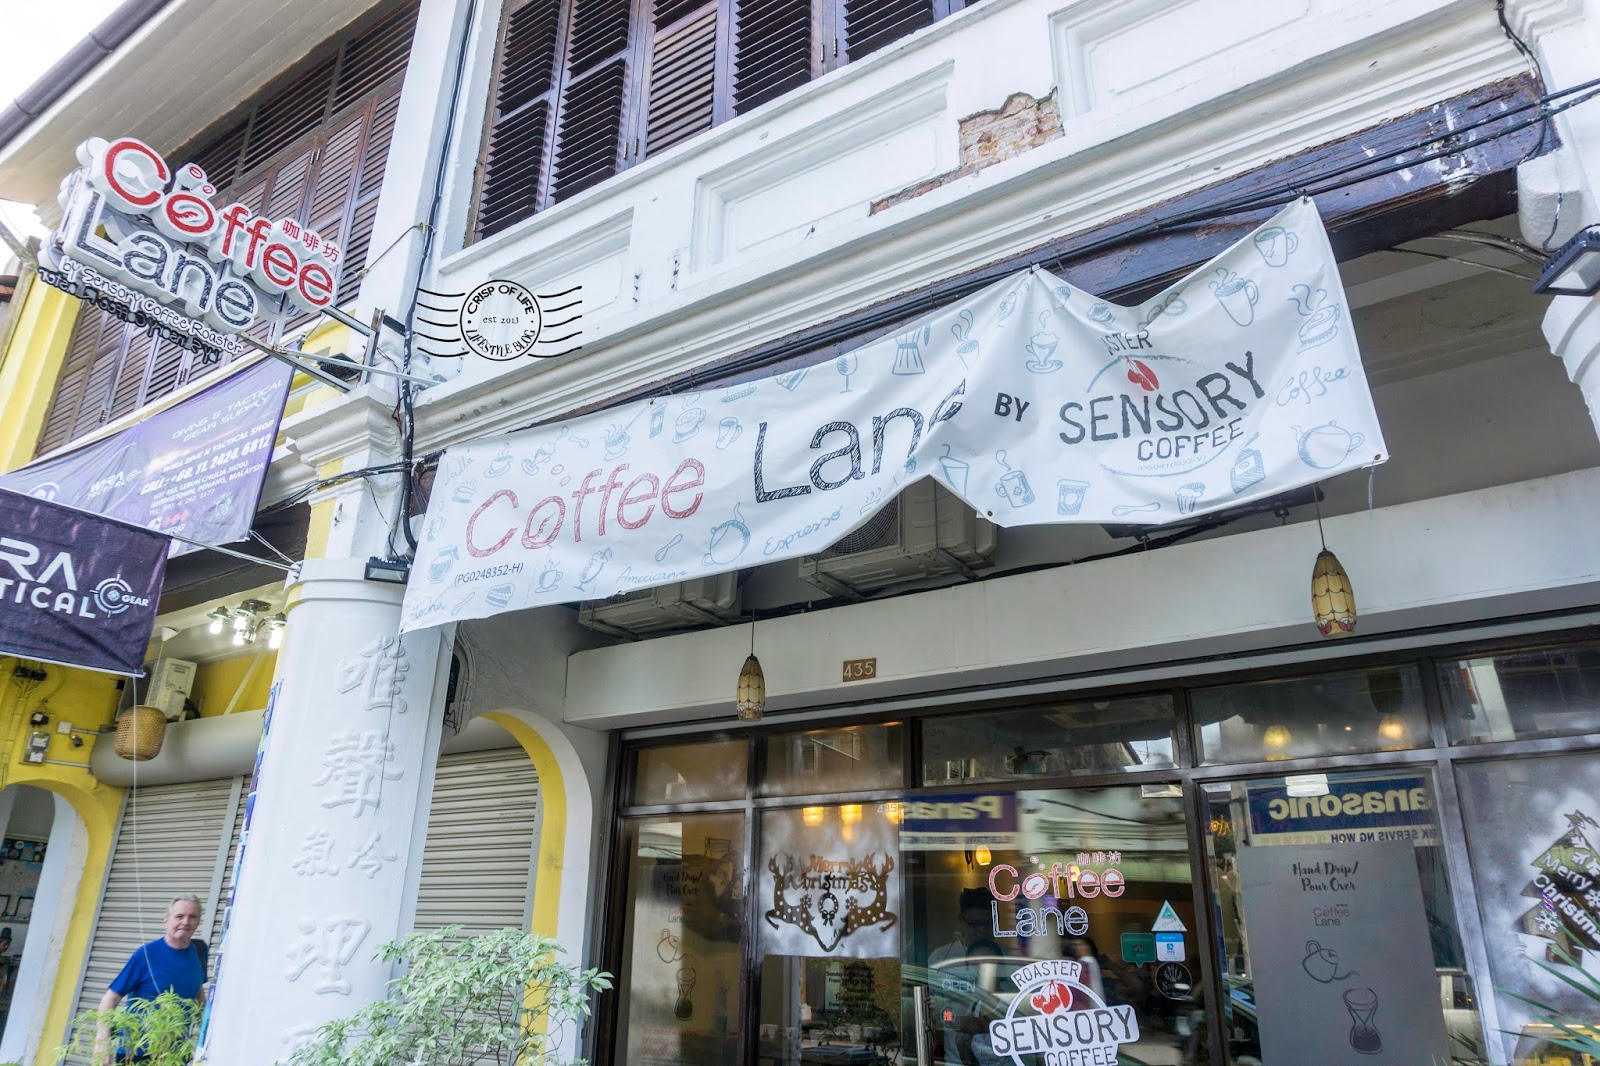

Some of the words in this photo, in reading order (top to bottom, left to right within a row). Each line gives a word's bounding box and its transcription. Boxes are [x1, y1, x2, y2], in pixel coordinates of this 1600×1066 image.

[103, 138, 335, 307] Coffee
[281, 217, 341, 263] 咖啡坊
[75, 190, 256, 328] Lane
[83, 267, 145, 313] Sensory
[143, 298, 189, 332] Coffee
[189, 319, 243, 355] Roaster
[226, 379, 284, 413] TACTICAL
[1058, 349, 1266, 445] SENSORY
[1276, 364, 1353, 407] Coffee
[994, 391, 1030, 423] BY
[249, 418, 275, 437] SHOP
[1137, 416, 1246, 462] COFFEE
[228, 462, 265, 480] MALAYSIA
[465, 457, 706, 560] Coffee
[762, 505, 843, 557] Espresso
[453, 561, 525, 588] (PG0248352-H)
[615, 565, 689, 585] Americano
[120, 593, 150, 608] GEAR
[843, 660, 874, 678] 435
[988, 861, 1126, 902] Coffee
[1291, 861, 1322, 877] Hand
[1323, 860, 1359, 878] Drip/
[1301, 877, 1329, 892] Pour
[1329, 876, 1357, 893] Over
[1541, 853, 1594, 890] Merry
[990, 899, 1089, 938] Lane
[1312, 906, 1350, 918] Coffee
[1314, 916, 1341, 927] Lane
[941, 979, 976, 993] OPEN
[1012, 961, 1080, 988] ROASTER
[991, 1006, 1132, 1054] SENSORY
[1045, 1045, 1117, 1066] COFFEE
